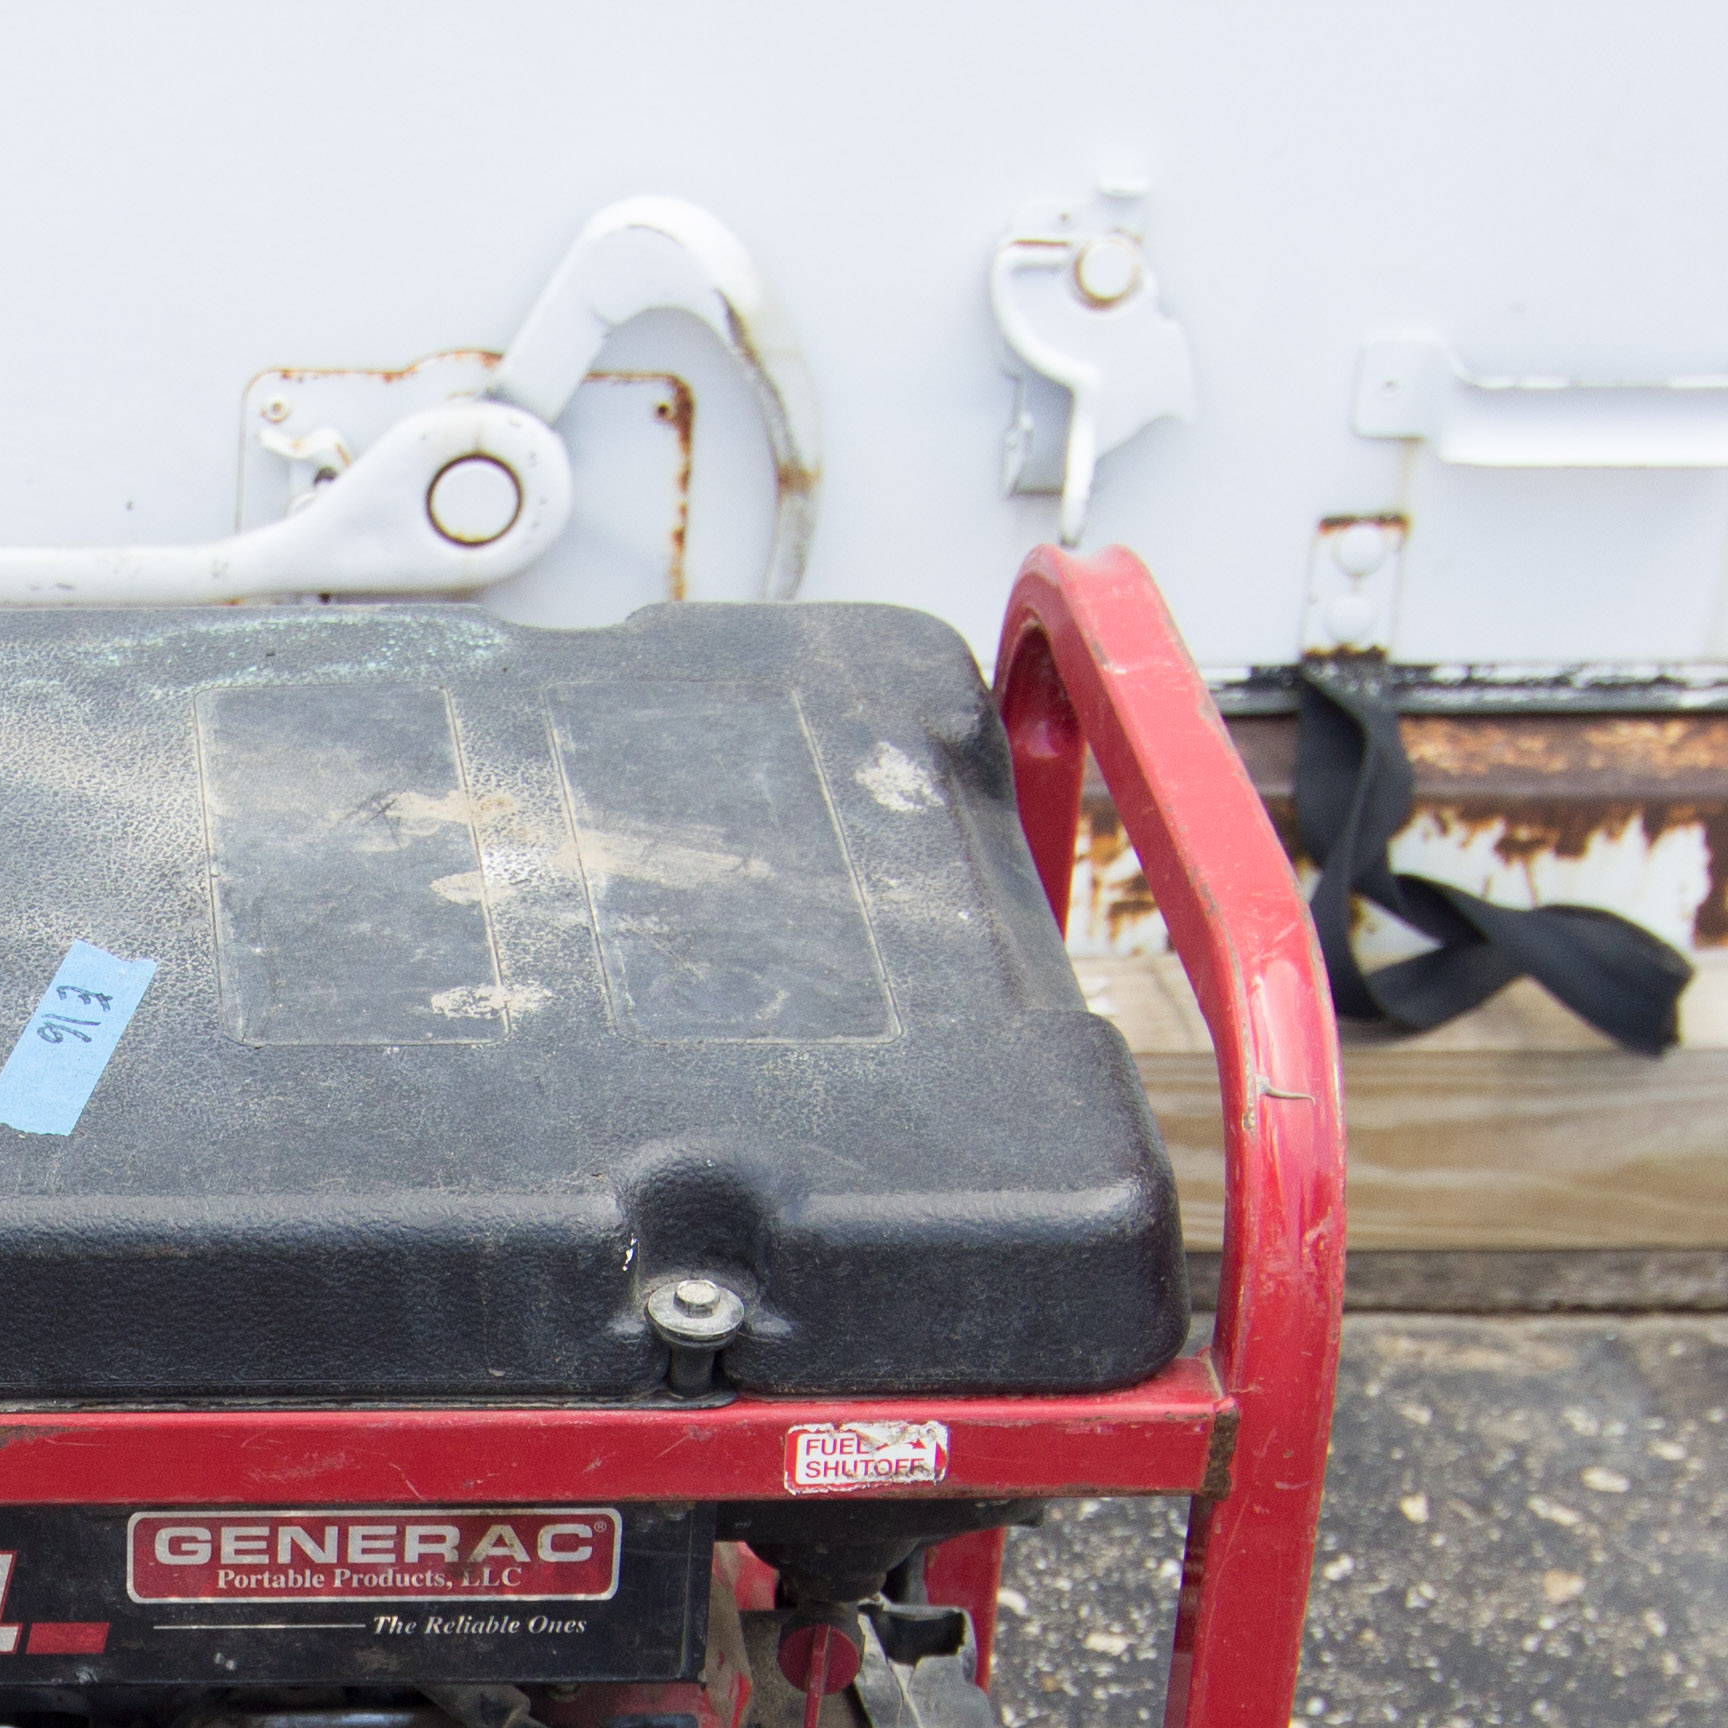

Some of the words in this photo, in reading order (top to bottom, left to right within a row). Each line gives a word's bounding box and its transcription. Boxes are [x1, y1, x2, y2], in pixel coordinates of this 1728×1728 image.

[805, 1437, 870, 1456] FUEL
[216, 1568, 325, 1589] Portable
[334, 1567, 454, 1590] Products,
[462, 1566, 522, 1588] LLC
[373, 1615, 417, 1636] The
[425, 1615, 520, 1635] Reliable
[528, 1615, 587, 1634] Ones
